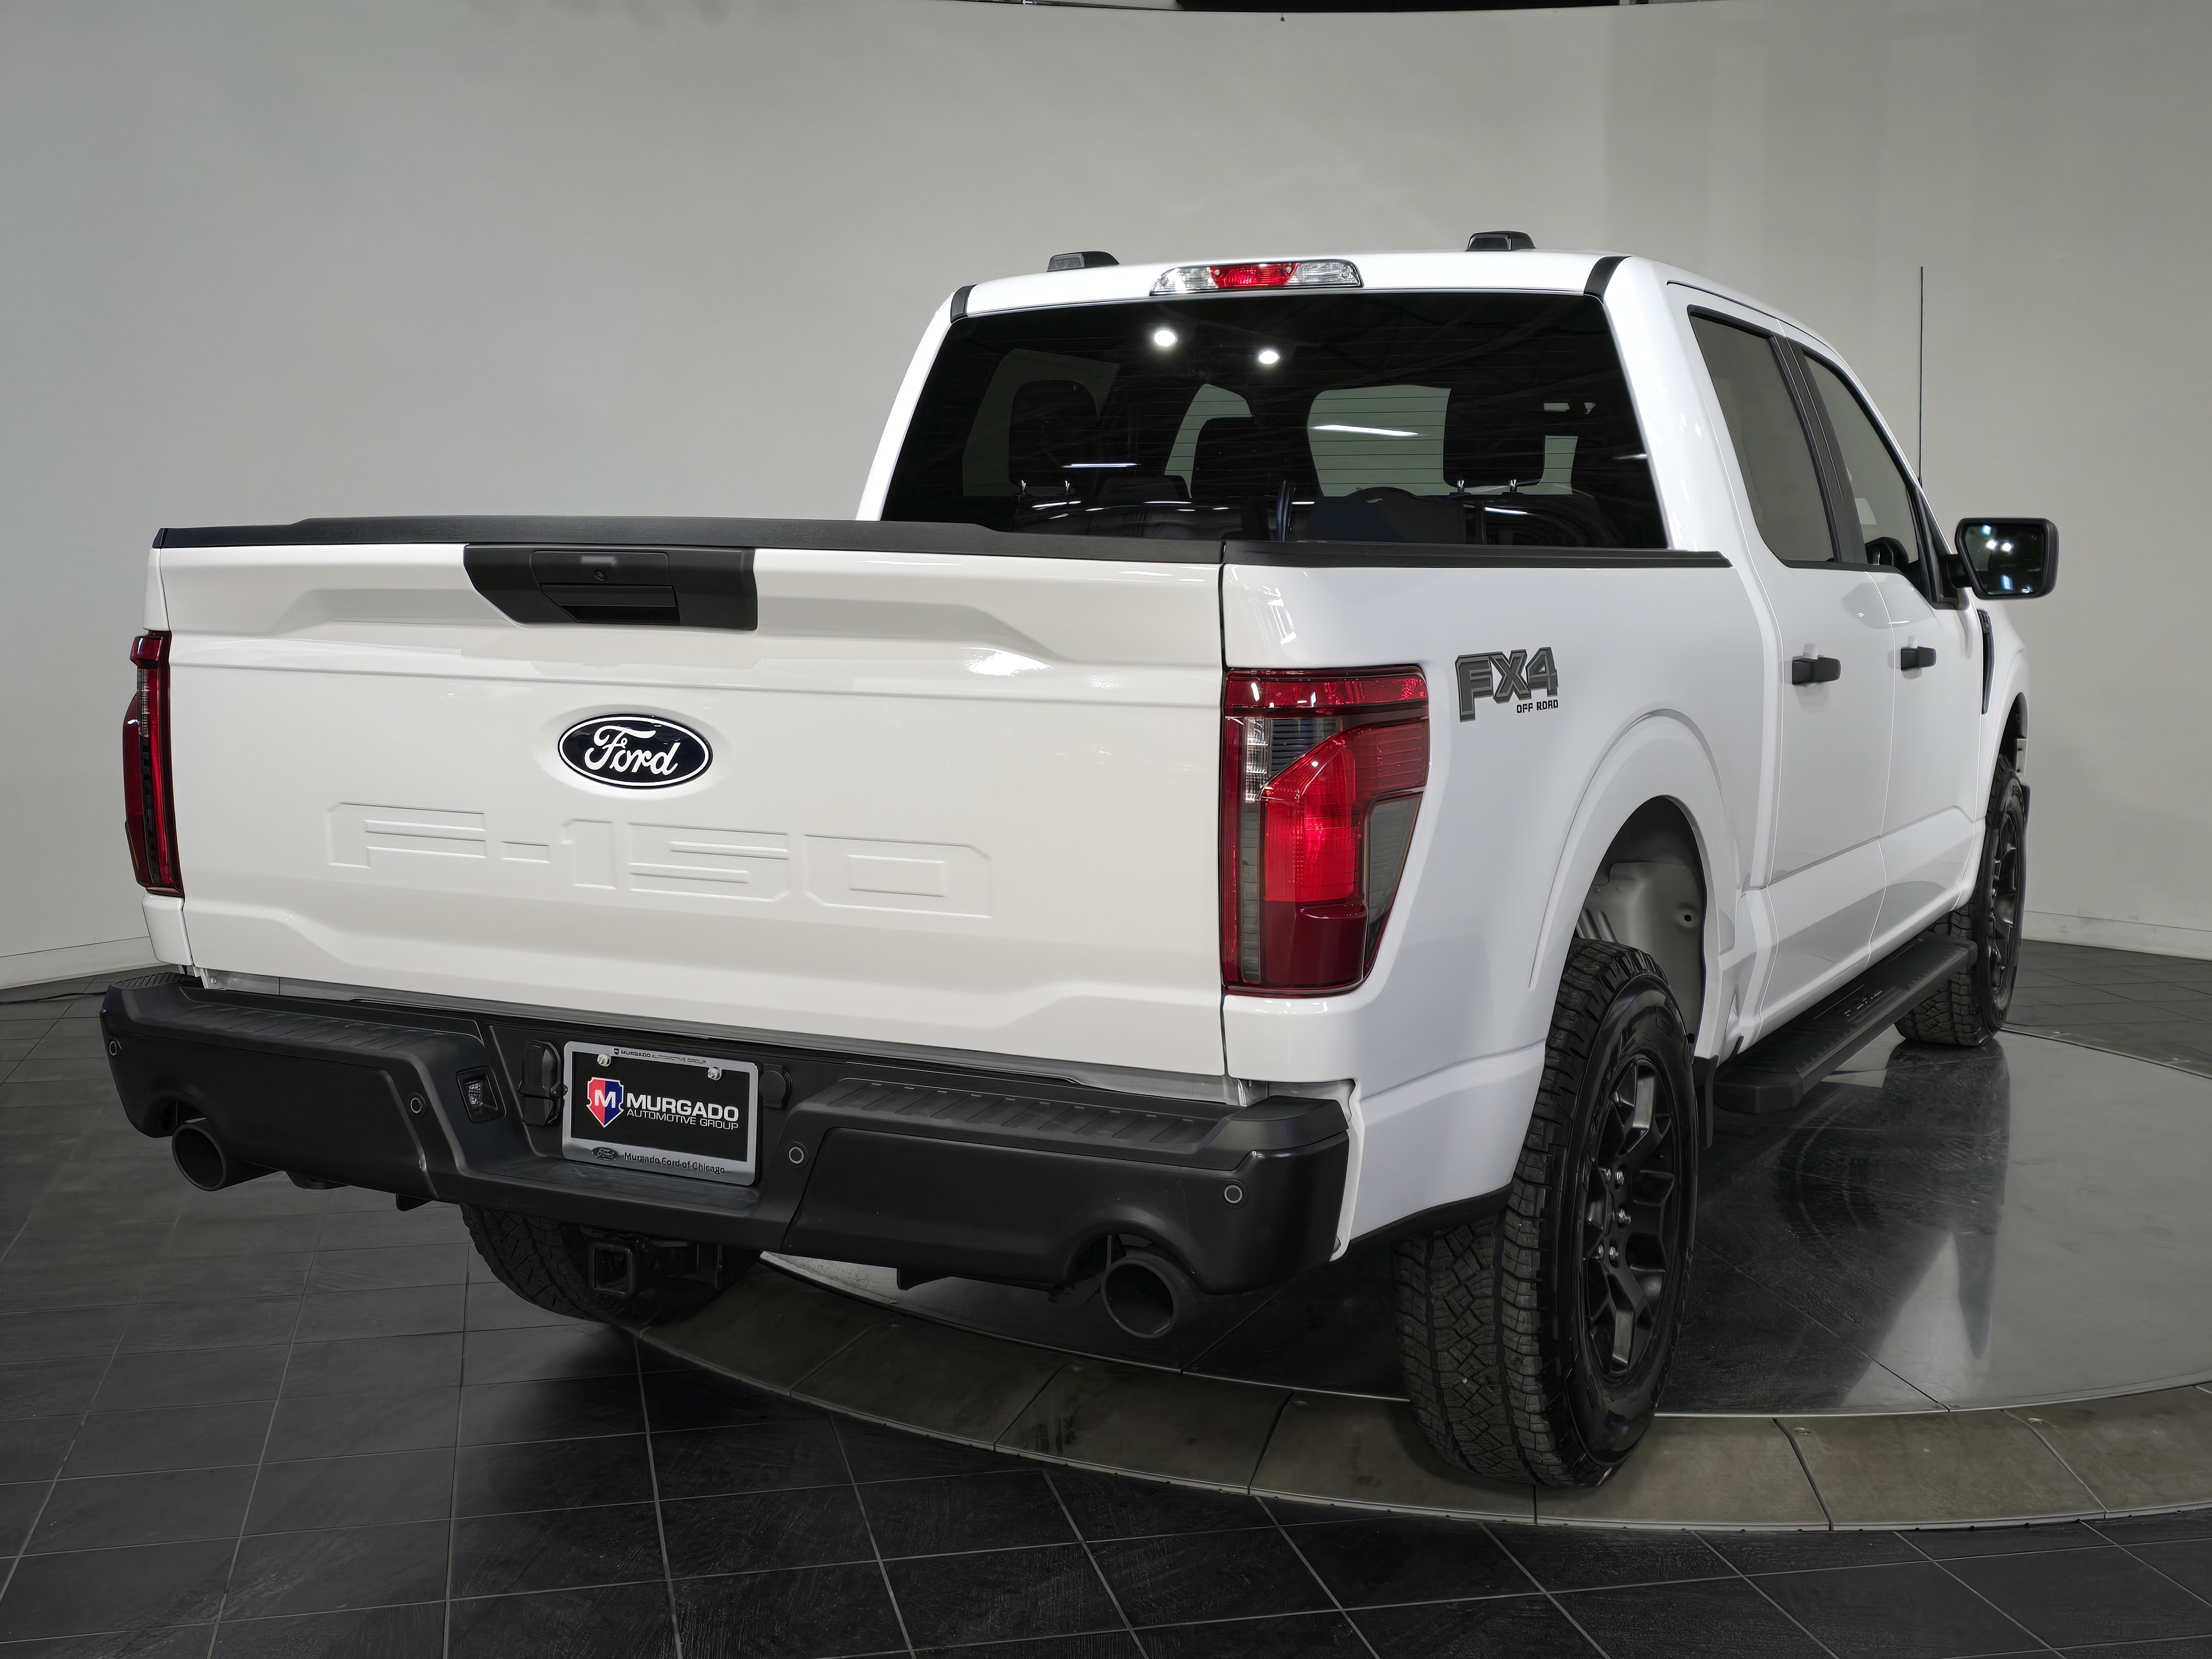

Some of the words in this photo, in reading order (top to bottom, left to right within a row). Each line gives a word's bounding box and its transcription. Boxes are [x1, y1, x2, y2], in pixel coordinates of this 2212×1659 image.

[1455, 646, 1558, 722] FX4
[1516, 702, 1533, 713] OFF
[1536, 699, 1558, 711] ROAD
[584, 725, 681, 776] Ford
[326, 802, 993, 918] F-150
[594, 1089, 617, 1109] M
[627, 1093, 739, 1121] MURGADO
[627, 1109, 697, 1125] AUTOMOTIVE
[700, 1118, 739, 1130] GROUP
[682, 1160, 691, 1170] of
[692, 1162, 725, 1175] Chicago
